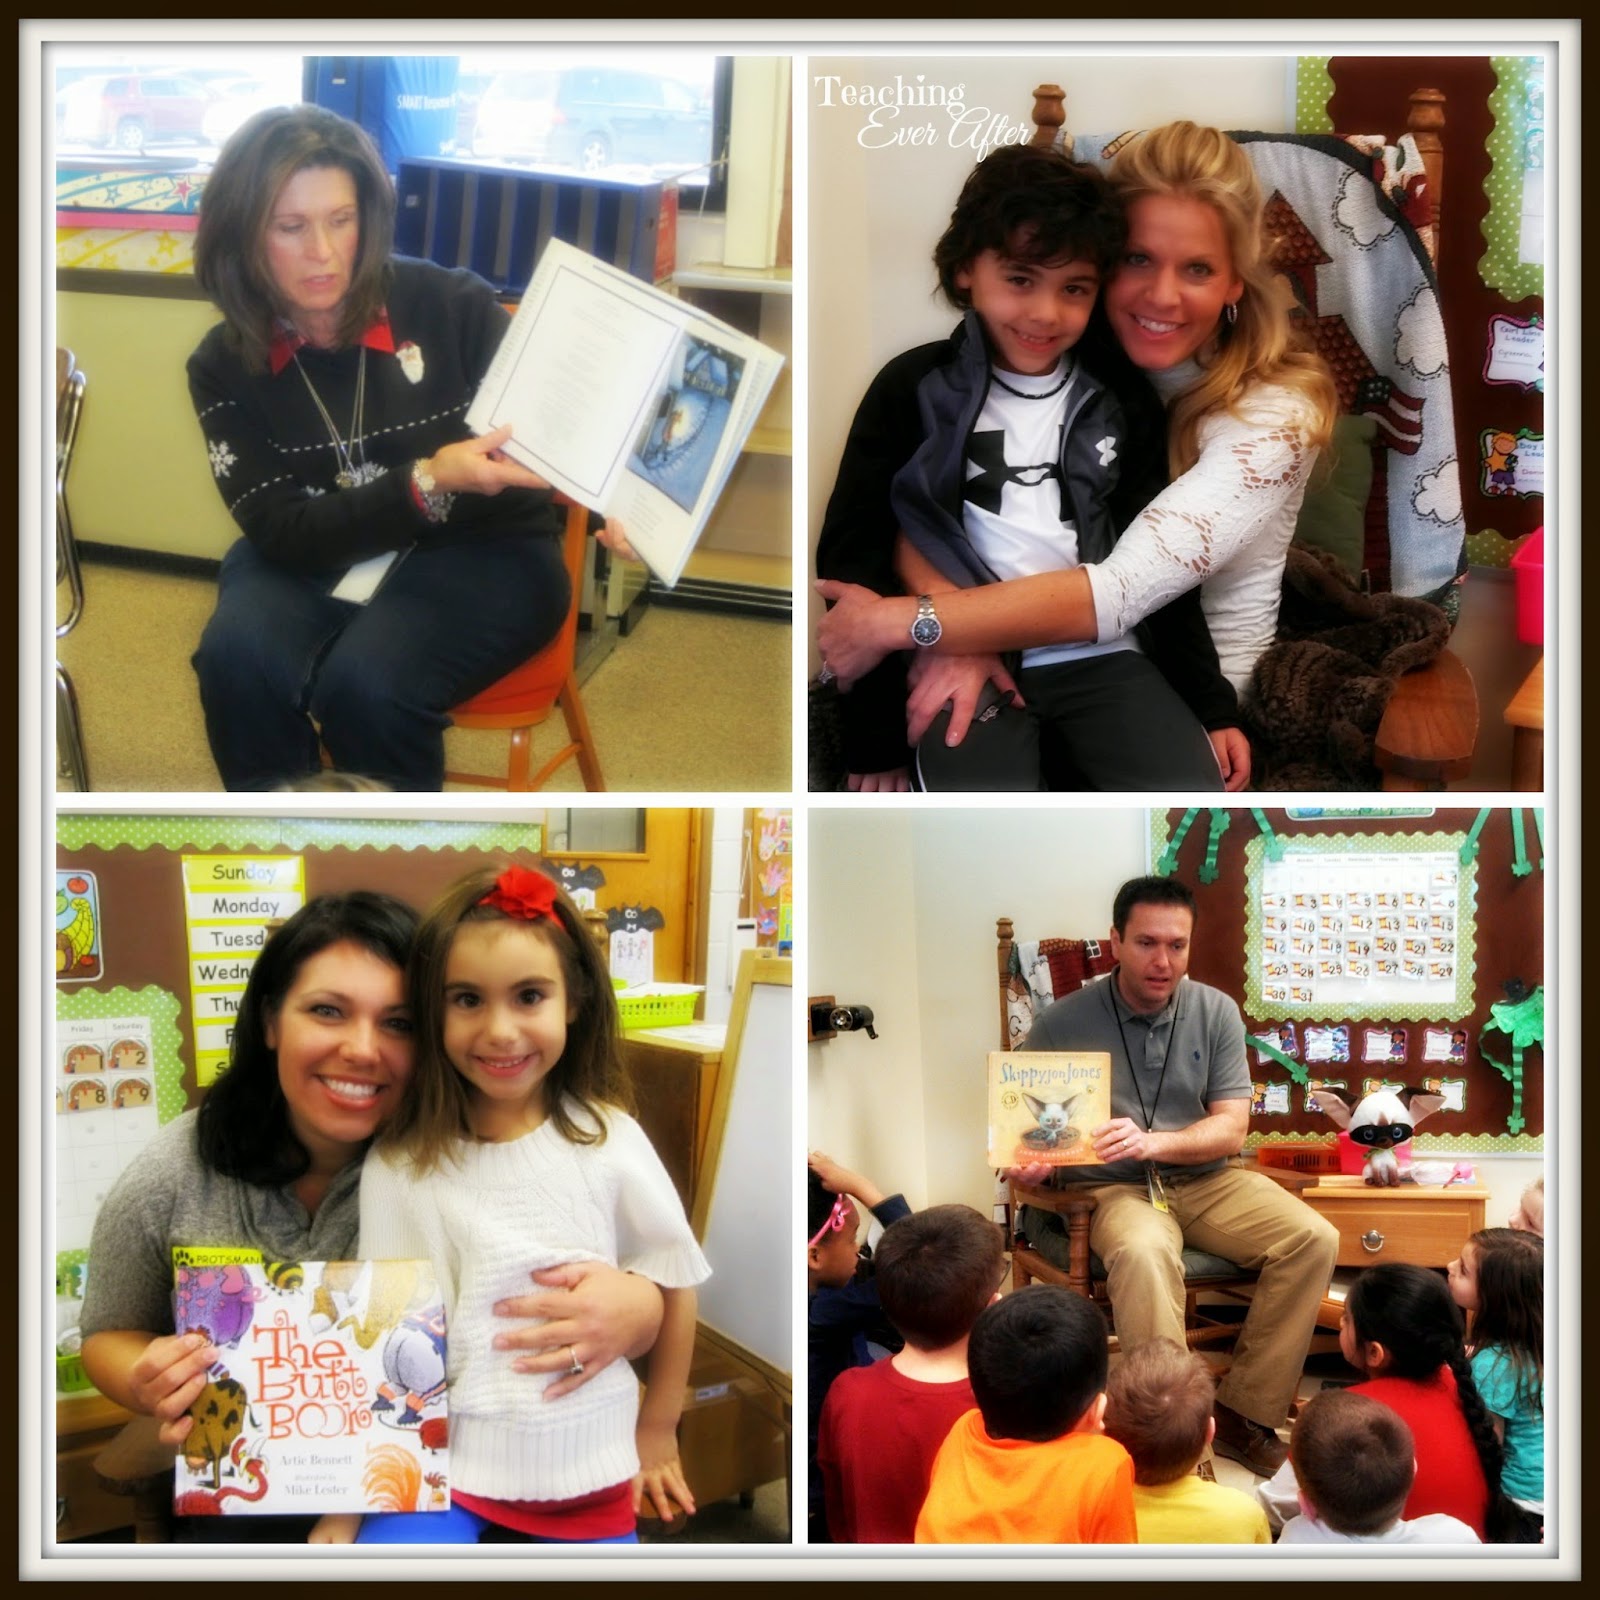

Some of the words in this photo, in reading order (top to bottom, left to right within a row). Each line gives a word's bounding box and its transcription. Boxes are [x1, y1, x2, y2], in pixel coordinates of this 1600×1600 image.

[212, 863, 277, 885] Sunday
[213, 897, 280, 917] Monday
[1280, 897, 1286, 907] 2
[1310, 898, 1317, 909] 3
[1360, 919, 1373, 929] 12
[1388, 920, 1400, 931] 13
[211, 930, 265, 947] Tuesd
[1383, 942, 1397, 952] 20
[1440, 943, 1454, 953] 22
[1274, 964, 1288, 976] 23
[1329, 964, 1343, 975] 25
[1385, 963, 1399, 975] 27
[1439, 967, 1453, 977] 29
[1271, 990, 1286, 1000] 30
[136, 1051, 146, 1065] 2
[95, 1089, 106, 1103] 8
[139, 1087, 149, 1101] 9
[252, 1309, 348, 1369] The
[251, 1356, 368, 1403] Butt
[280, 1455, 307, 1467] Artie
[310, 1454, 353, 1466] Bennett
[284, 1484, 312, 1496] Mike
[314, 1484, 349, 1496] Lester
